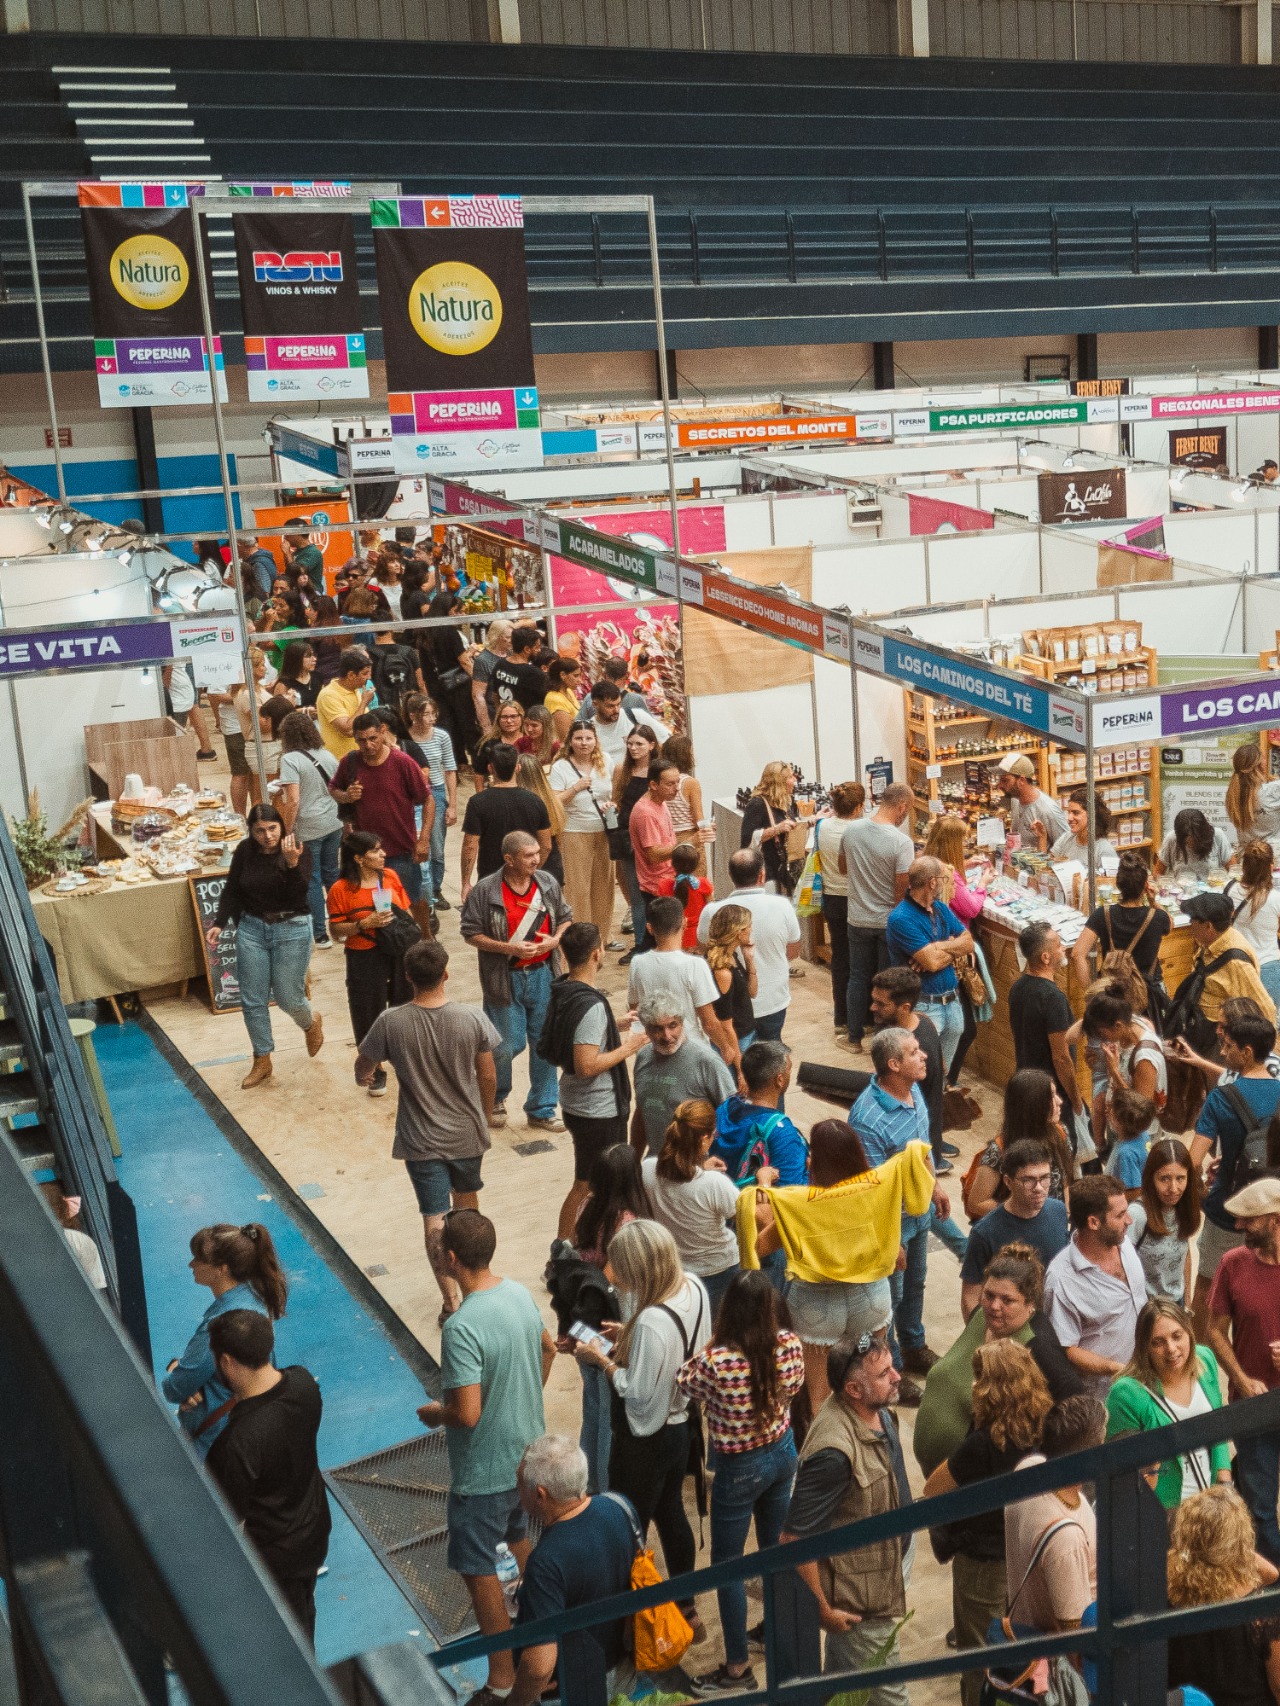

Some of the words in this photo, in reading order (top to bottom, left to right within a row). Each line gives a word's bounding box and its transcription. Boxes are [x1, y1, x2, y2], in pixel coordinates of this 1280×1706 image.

[119, 258, 181, 283] Natura
[265, 286, 293, 295] VINOS
[294, 286, 301, 295] &
[302, 286, 338, 295] WHISKY
[420, 292, 494, 323] Natura
[443, 330, 475, 340] ADEREZOS
[1076, 380, 1101, 397] FERNET
[1101, 379, 1123, 396] BENEY
[1159, 398, 1245, 413] REGIONALES
[939, 414, 968, 427] PSA
[970, 408, 1078, 425] PURIFICADORES
[688, 425, 765, 441] SECRETOS
[768, 424, 795, 437] DEL
[797, 422, 847, 434] MONTE
[1175, 436, 1199, 458] FERNET
[1200, 434, 1220, 455] BENEY
[569, 535, 646, 577] ACARAMELADOS
[743, 598, 765, 616] DECO
[763, 603, 786, 626] HOME
[785, 614, 820, 638] AROMAS
[34, 635, 122, 661] VITA
[180, 631, 219, 647] Becerra
[496, 670, 519, 685] CREW
[897, 652, 922, 676] LOS
[922, 661, 985, 697] CAMINOS
[985, 682, 1012, 708] DEL
[1013, 690, 1033, 715] TÉ
[1182, 697, 1234, 723] LOS
